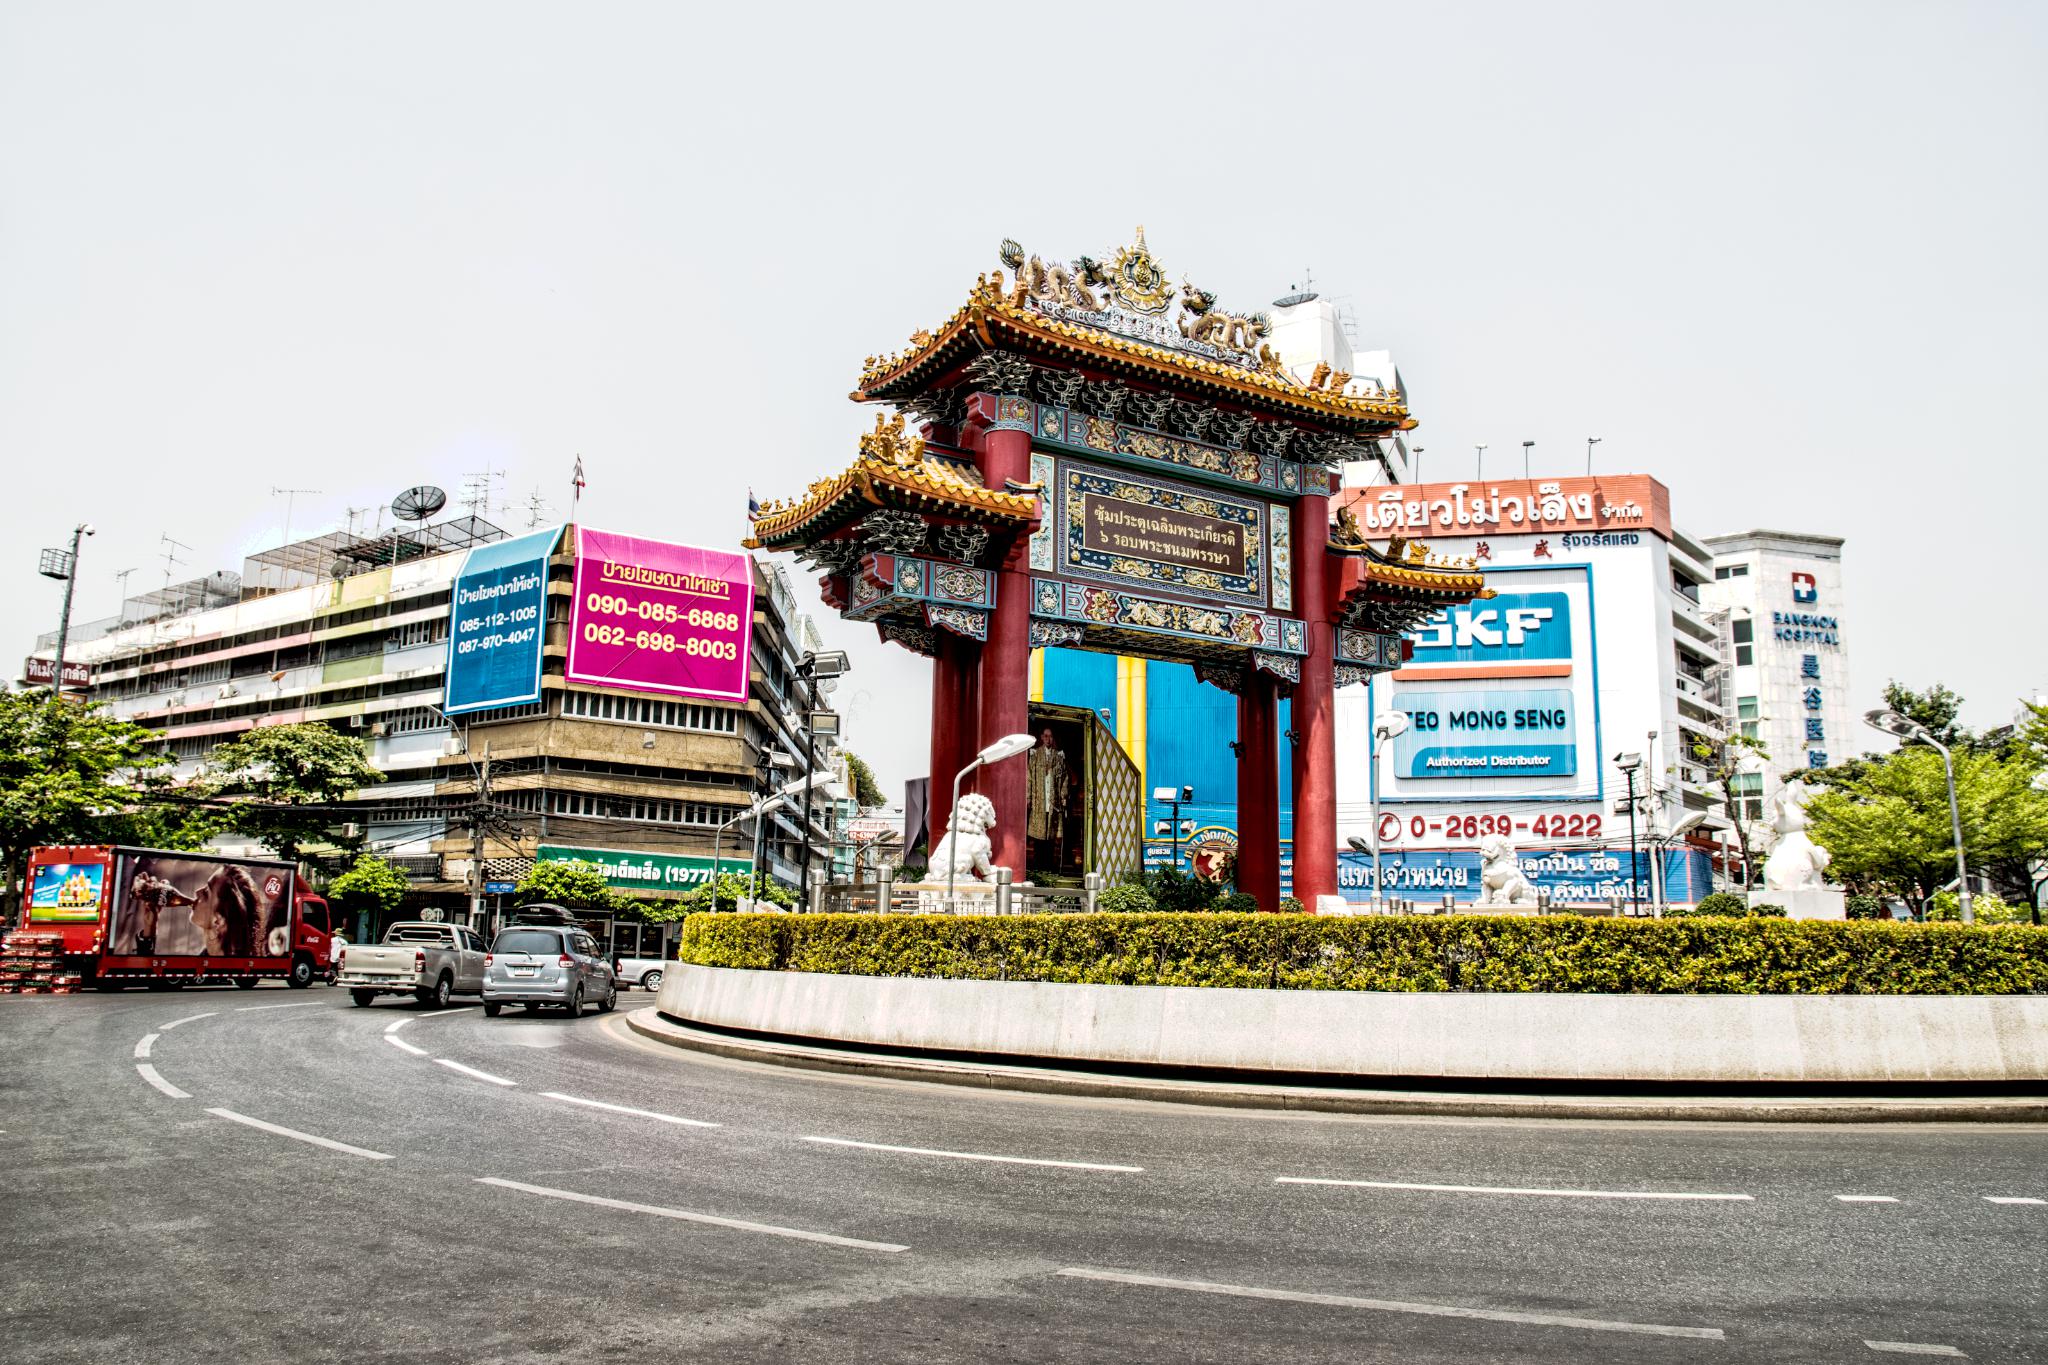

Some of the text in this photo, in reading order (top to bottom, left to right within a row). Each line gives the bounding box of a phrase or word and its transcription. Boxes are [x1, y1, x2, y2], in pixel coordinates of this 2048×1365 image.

[1601, 501, 1643, 518] จำกัด
[1094, 505, 1236, 547] ซุ้มประตูเฉลิมพระเกียรติ
[1099, 530, 1230, 566] ๖ รอบพระชนมพรรษา
[459, 573, 540, 605] ป้ายโฆษณาให้เช่า
[603, 558, 729, 595] ป้ายโฆษณาให้เช่า
[460, 605, 537, 633] 085-112-1005
[587, 593, 739, 632] 090-085-6868
[1773, 612, 1838, 629] BANGKOK
[458, 628, 535, 654] 087-970-4047
[584, 623, 737, 660] 062-698-8003
[1774, 628, 1839, 646] HOSPITAL
[1449, 710, 1507, 729] MONG
[1514, 709, 1566, 728] SENG
[1426, 755, 1551, 768] Authorized Distributor
[1410, 813, 1602, 838] 0-2639-4222
[665, 865, 714, 884] (1977)
